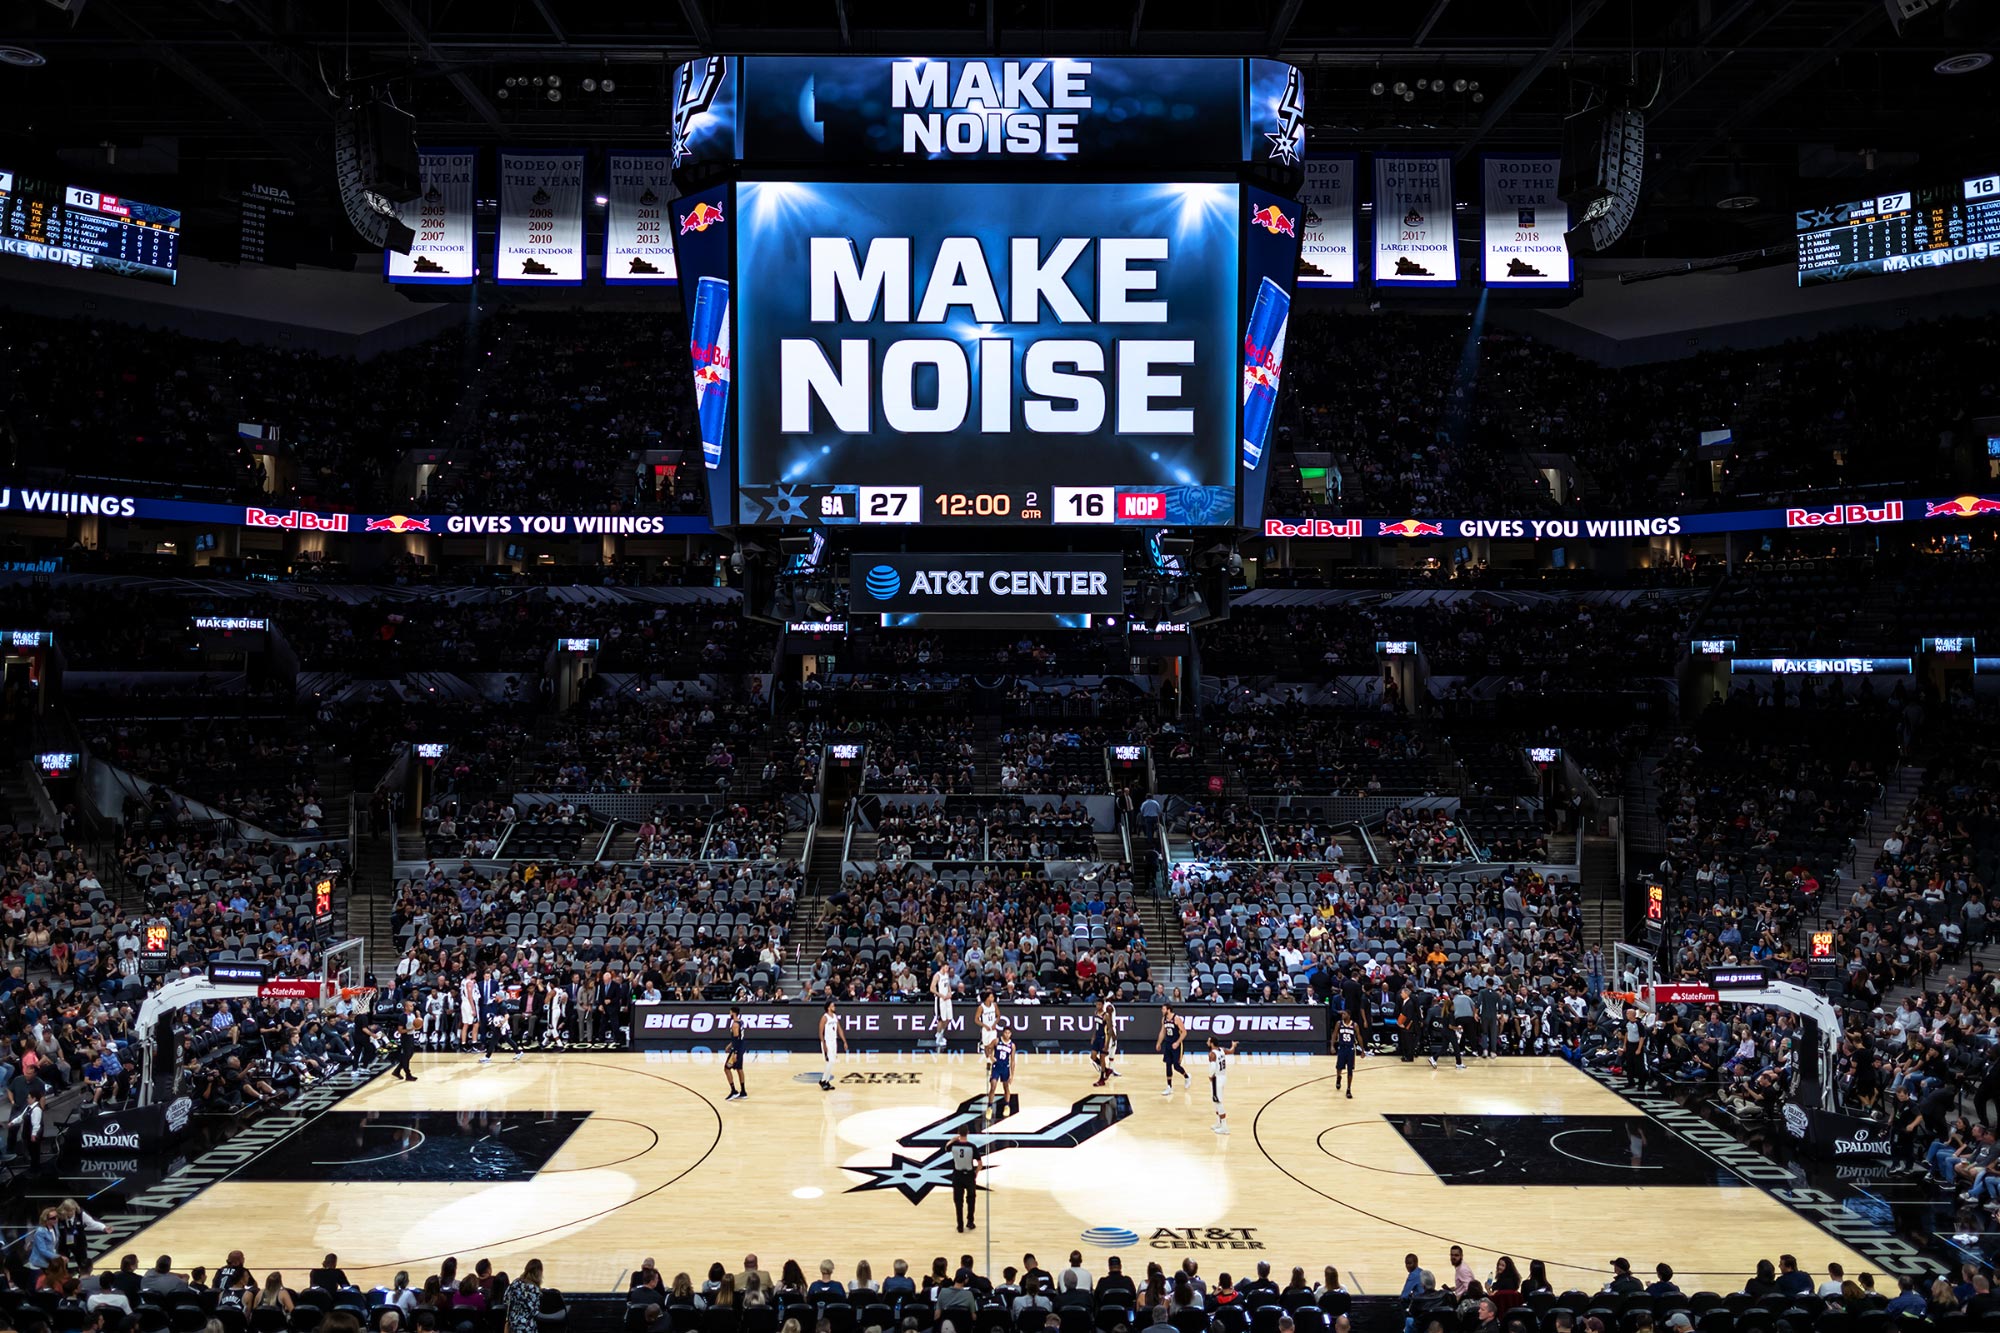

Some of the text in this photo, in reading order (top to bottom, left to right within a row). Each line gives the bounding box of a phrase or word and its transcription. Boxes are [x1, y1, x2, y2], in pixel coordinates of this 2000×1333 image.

[891, 61, 1092, 108] MAKE
[903, 113, 1079, 153] NOISE
[453, 157, 471, 166] OF
[504, 160, 582, 170] RODEO OF
[613, 160, 664, 170] RODEO
[1388, 163, 1437, 172] RODEO
[1500, 163, 1552, 173] RODEO
[432, 173, 471, 183] YEAR
[505, 175, 580, 186] THE YEAR
[613, 176, 643, 186] THE
[1387, 178, 1439, 188] OF THE
[1309, 180, 1341, 189] THE
[1498, 179, 1554, 189] OF THE
[1973, 179, 1993, 194] 16
[257, 185, 290, 199] NBA
[74, 191, 93, 206] 16
[1395, 193, 1431, 203] YEAR
[1507, 195, 1546, 204] YEAR
[1882, 196, 1903, 210] 27
[421, 207, 445, 215] 2005
[529, 209, 553, 218] 2008
[637, 209, 660, 218] 2011
[421, 219, 445, 228] 2006
[529, 222, 553, 231] 2009
[637, 222, 660, 231] 2012
[421, 232, 445, 241] 2007
[529, 234, 553, 243] 2010
[637, 235, 660, 243] 2013
[1402, 231, 1426, 241] 2017
[1515, 232, 1539, 242] 2018
[1411, 244, 1448, 252] INDOOR
[32, 243, 93, 268] NOISE
[1883, 243, 2000, 272] MAKE NOISE
[810, 237, 1168, 322] MAKE
[780, 337, 1196, 433] NOISE
[20, 490, 136, 517] WIIINGS
[870, 493, 907, 516] 27
[935, 493, 1010, 516] 12:00
[1025, 491, 1037, 507] 2
[1068, 493, 1103, 516] 16
[821, 495, 844, 516] SA
[1125, 496, 1159, 516] NOP
[1021, 508, 1042, 519] QTR
[1786, 500, 1904, 528] Red Bull
[246, 507, 349, 532] Red Bull
[447, 515, 665, 534] GIVES YOU WIIINGS
[1264, 518, 1362, 538] Red Bull
[1459, 516, 1681, 537] GIVES YOU WIIINGS
[910, 570, 1108, 596] AT&T CENTER
[196, 618, 264, 629] MAKE NOISE
[12, 632, 40, 640] MAKE
[1771, 658, 1873, 674] MAKE NOISE
[418, 744, 443, 752] MAKE
[833, 745, 857, 753] MAKE
[1115, 745, 1140, 754] MAKE
[1531, 748, 1555, 756] MAKE
[41, 754, 72, 763] MAKE
[316, 895, 330, 915] 24
[1648, 898, 1661, 918] 24
[147, 938, 164, 951] 24
[1814, 943, 1830, 955] 24
[644, 1014, 690, 1029] BIG
[1342, 1033, 1351, 1042] 55
[81, 1134, 139, 1149] SPALDING
[1834, 1139, 1892, 1155] SPALDING
[959, 1148, 965, 1158] 3
[126, 1117, 307, 1208] ANTONIO
[1630, 1098, 1952, 1275] ANTONIO SPURS
[1149, 1227, 1258, 1240] AT&T
[1150, 1240, 1266, 1250] CENTER
